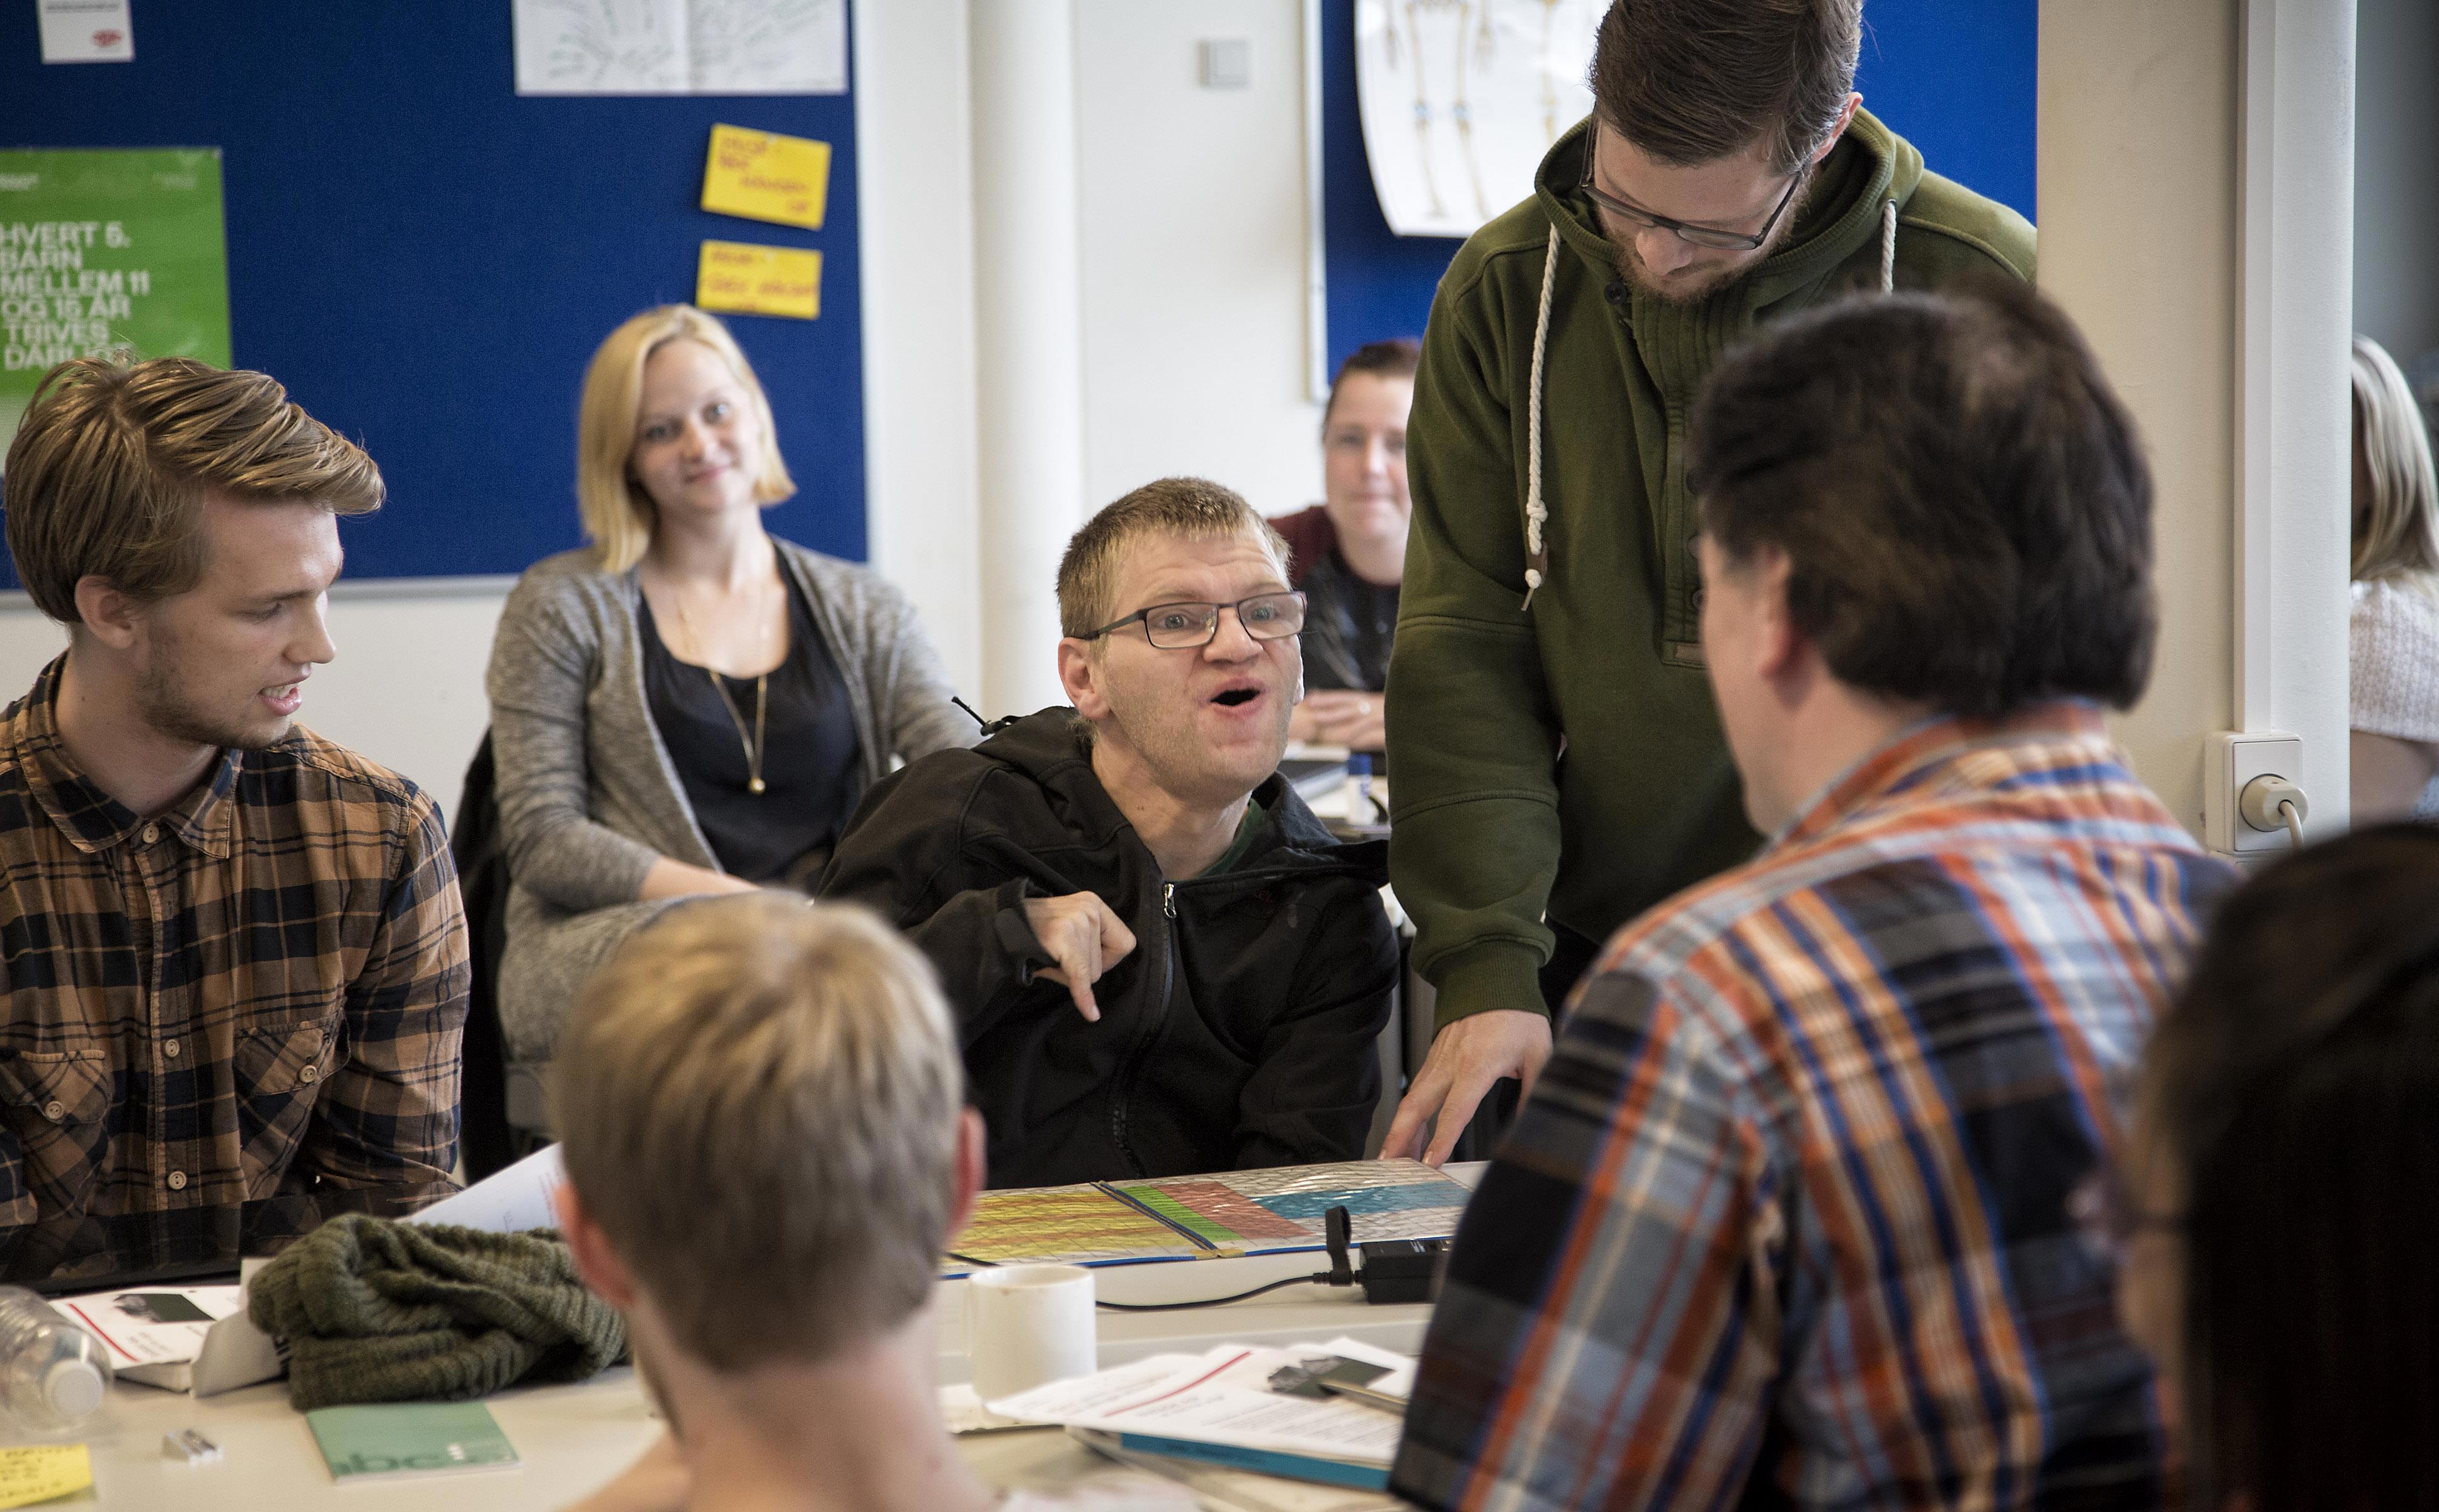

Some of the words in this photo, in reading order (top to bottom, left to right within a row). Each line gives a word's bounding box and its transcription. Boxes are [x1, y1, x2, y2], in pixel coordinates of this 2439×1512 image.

[0, 222, 98, 246] HVERT
[0, 246, 83, 270] BARN
[1, 271, 123, 295] MELLEM
[129, 270, 151, 295] 11
[2, 295, 47, 318] OG
[4, 319, 108, 344] TRIVES
